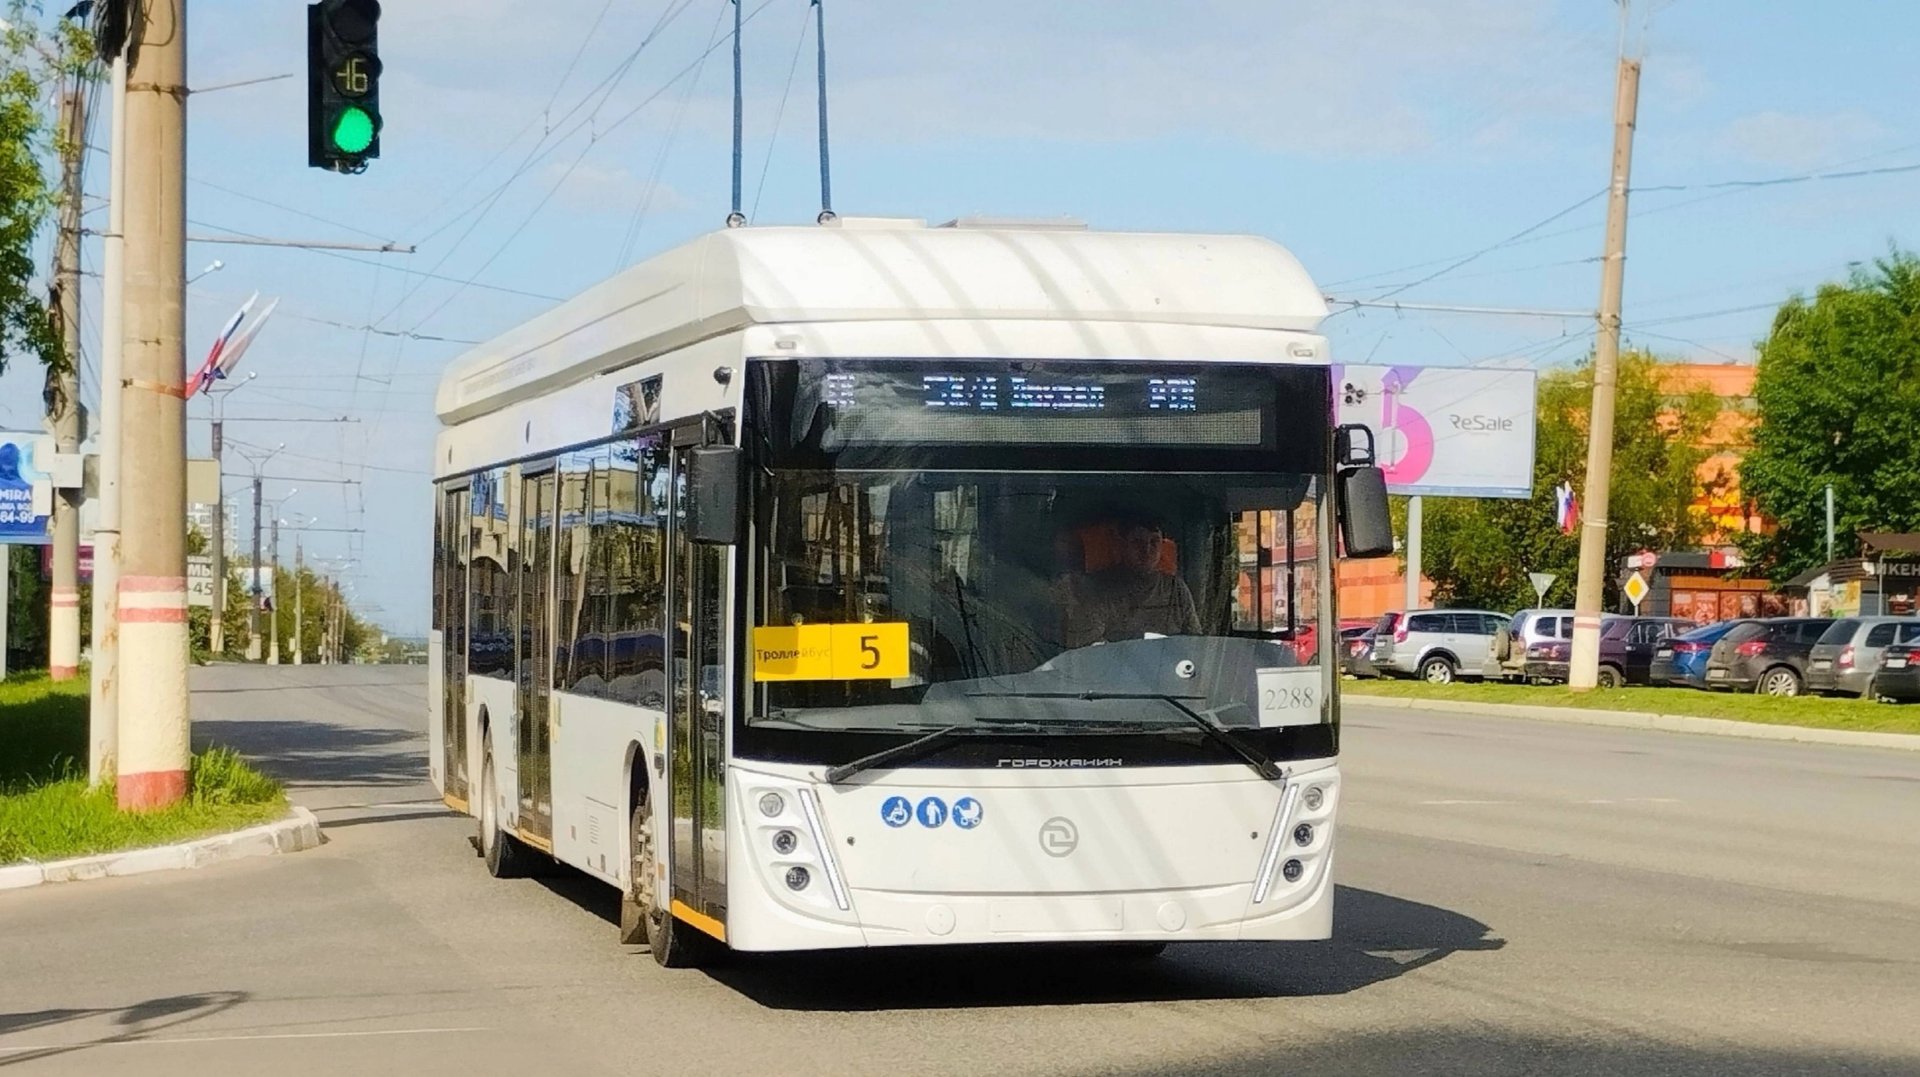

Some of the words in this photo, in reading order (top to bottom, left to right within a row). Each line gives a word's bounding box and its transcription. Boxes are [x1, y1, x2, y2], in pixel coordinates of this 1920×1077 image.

[1449, 414, 1513, 431] ReSale
[860, 634, 881, 670] 5
[1264, 686, 1314, 711] 2288
[995, 758, 1123, 768] ГОРОЖАНИН
